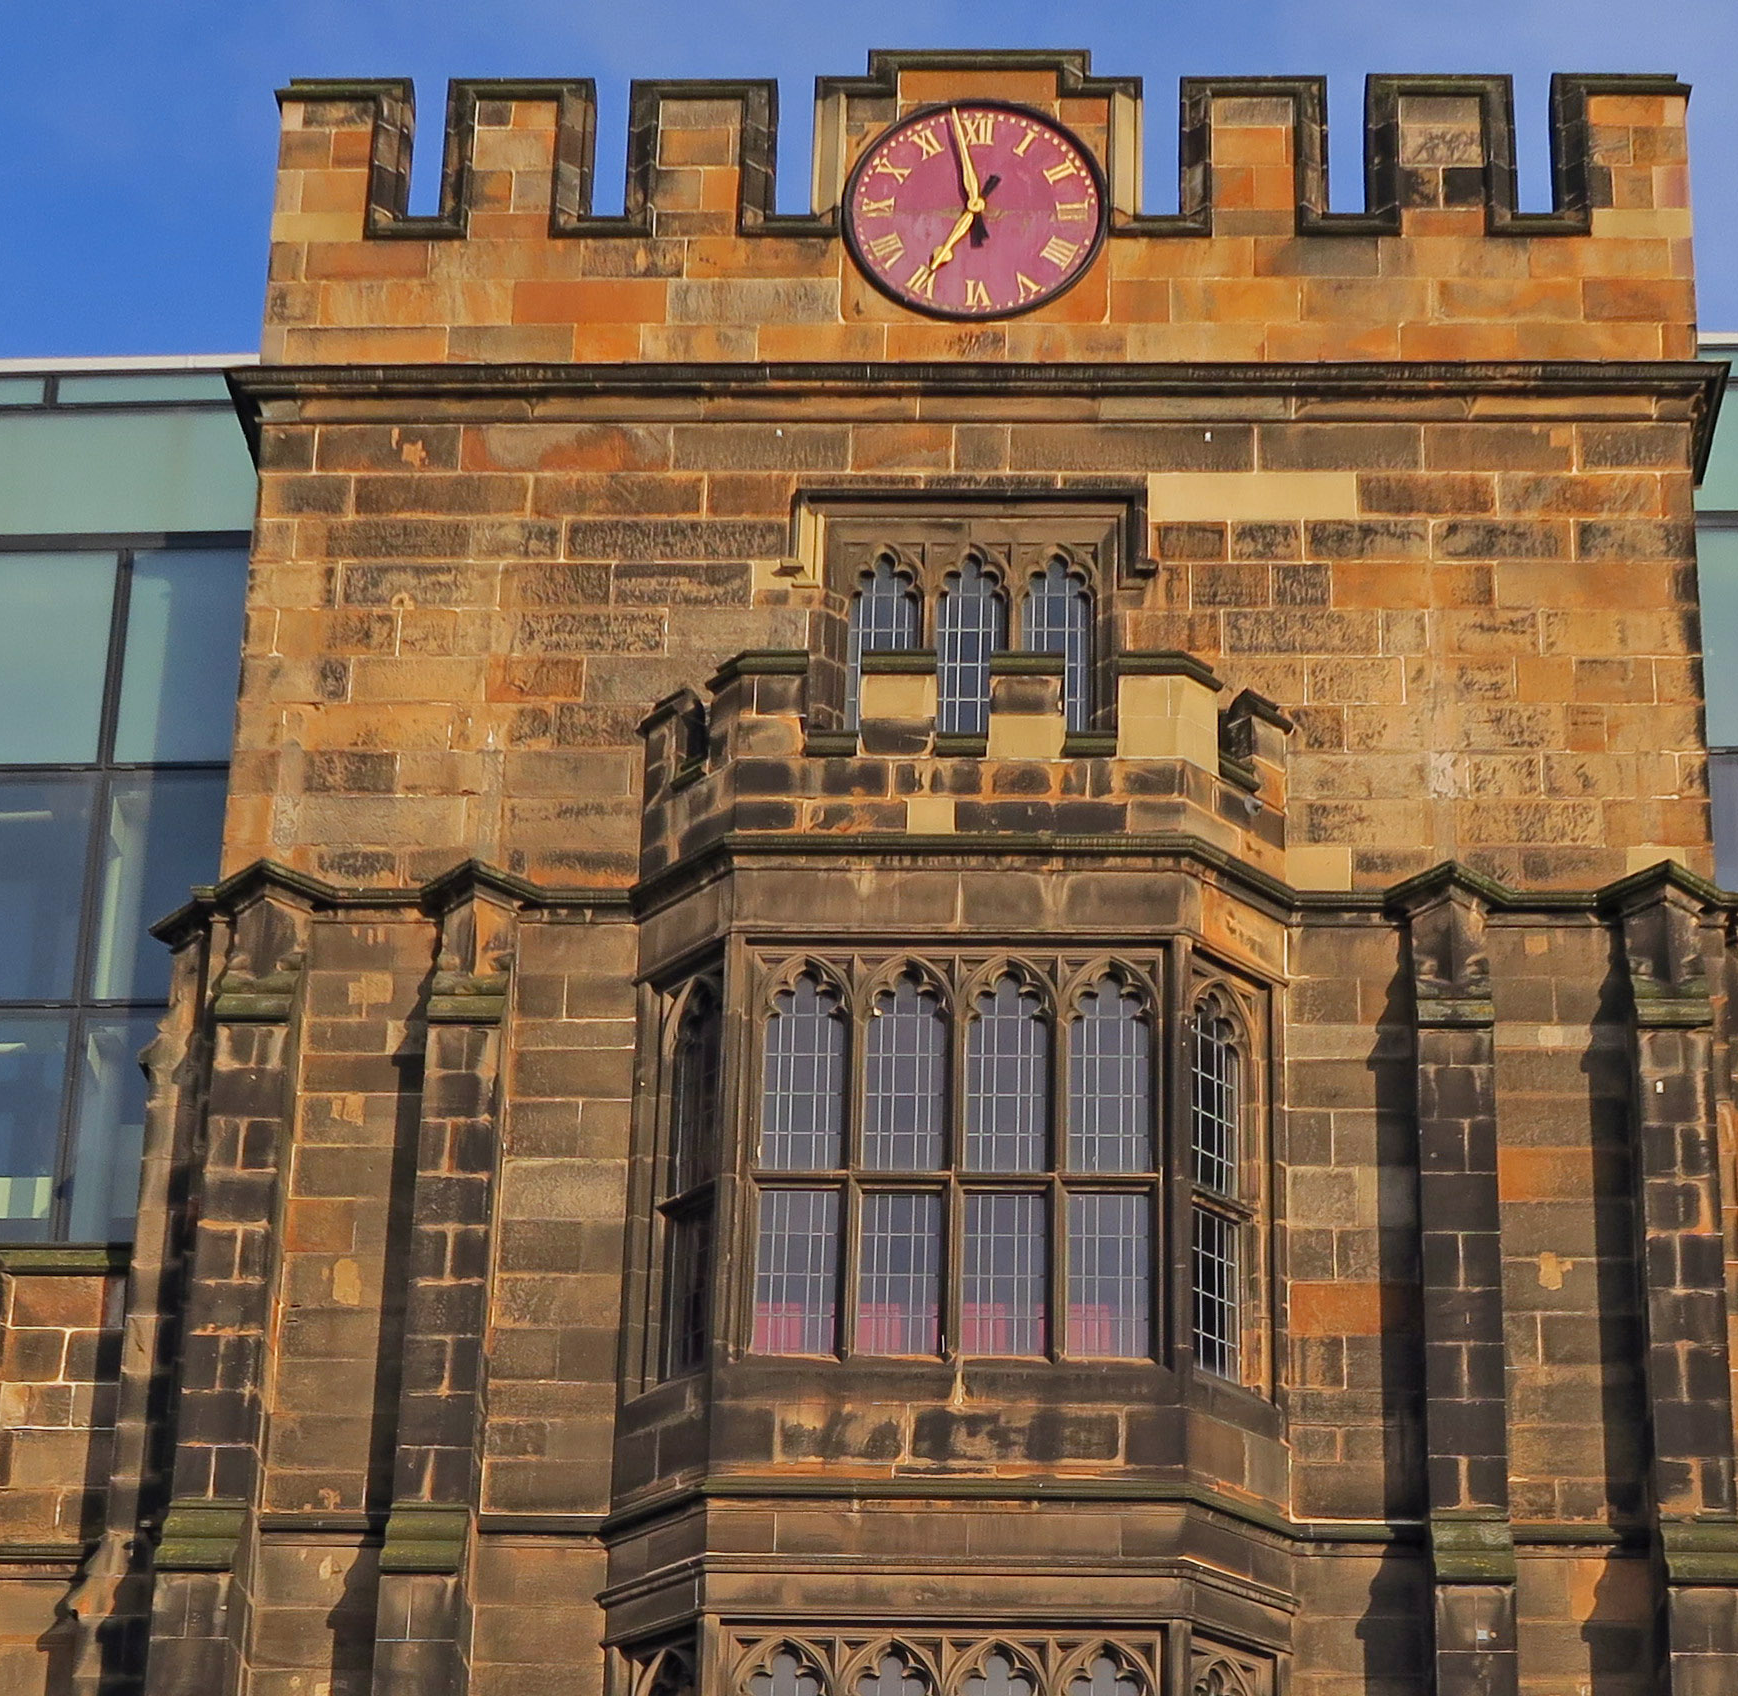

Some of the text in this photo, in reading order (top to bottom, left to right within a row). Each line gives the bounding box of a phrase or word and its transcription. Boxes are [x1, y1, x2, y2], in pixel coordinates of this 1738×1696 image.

[910, 127, 945, 161] XI
[963, 118, 994, 145] XII
[1013, 128, 1038, 157] I
[876, 157, 911, 185] X
[1043, 158, 1079, 185] II
[1055, 200, 1089, 222] III
[965, 279, 993, 307] VI
[1016, 271, 1043, 297] V
